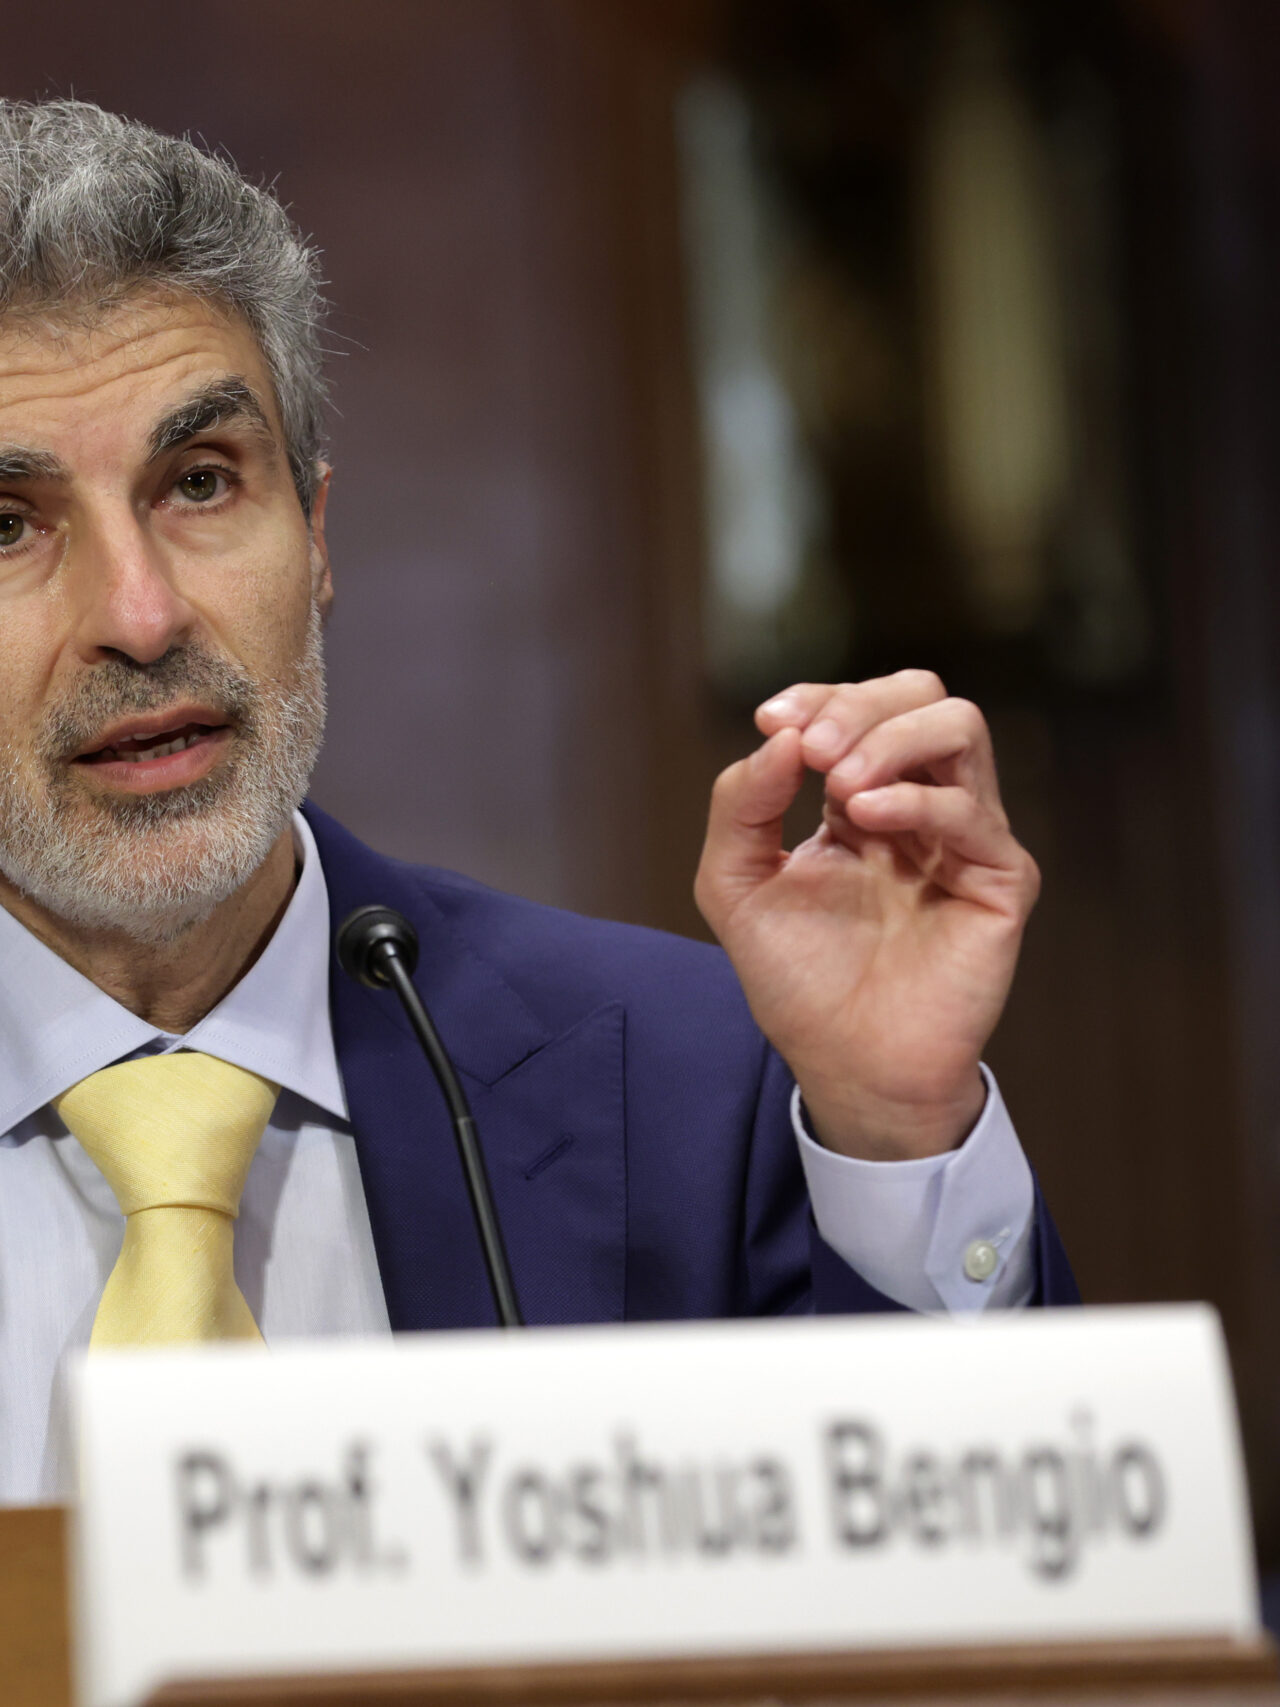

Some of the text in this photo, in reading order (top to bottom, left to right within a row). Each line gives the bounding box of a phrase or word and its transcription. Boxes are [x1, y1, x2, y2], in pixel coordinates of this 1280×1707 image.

[174, 1408, 1169, 1588] Prof. Yoshua Bengio
